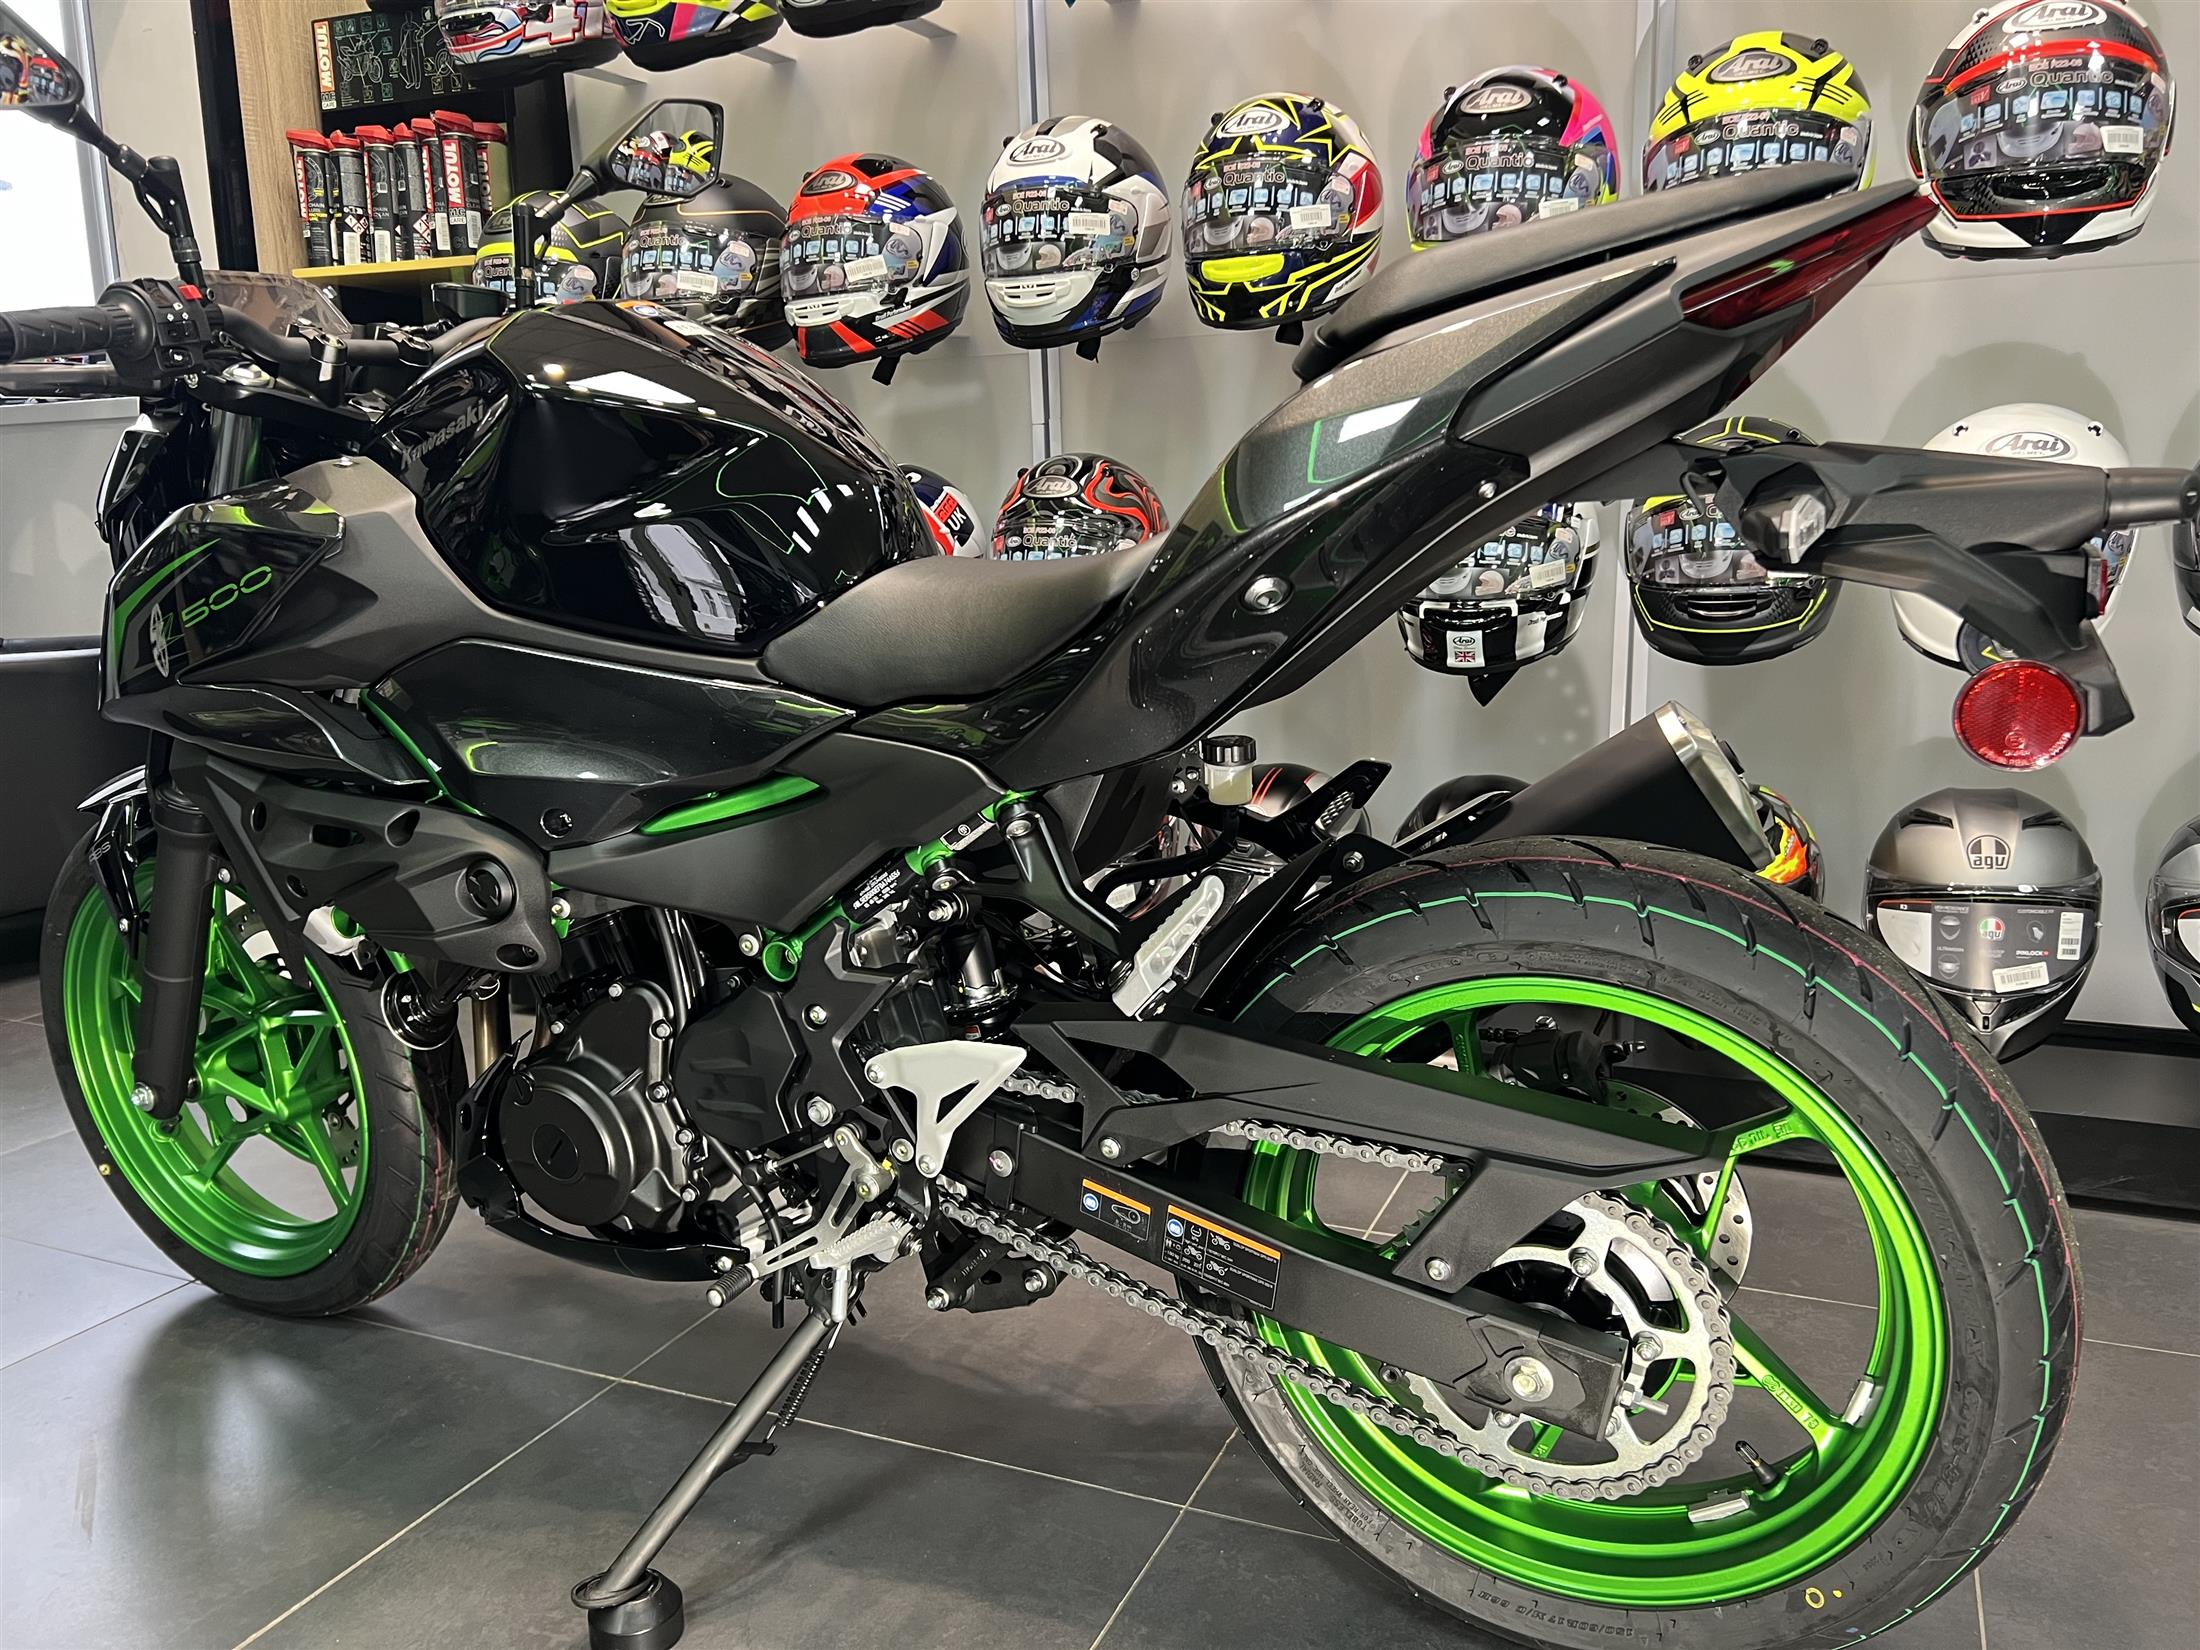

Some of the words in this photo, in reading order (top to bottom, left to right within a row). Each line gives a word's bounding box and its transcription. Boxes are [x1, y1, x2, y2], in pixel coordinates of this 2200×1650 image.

[2026, 2, 2087, 18] Arai
[315, 23, 333, 88] MOTUL
[1727, 56, 1780, 72] Arai
[2030, 70, 2113, 87] Quantic
[1472, 89, 1521, 105] Arai
[1233, 112, 1272, 126] Arai
[1723, 120, 1799, 140] Quantic
[1021, 142, 1056, 156] Arai
[1466, 151, 1534, 170] Quantic
[445, 142, 462, 204] MOTUL
[1223, 168, 1286, 186] Quantic
[813, 174, 845, 190] Arai
[1013, 197, 1070, 213] Quantic
[802, 222, 851, 238] Quantic
[639, 233, 688, 248] Quantic
[485, 267, 512, 278] Quan
[401, 399, 484, 470] Kawasaki
[1999, 433, 2061, 453] Arai
[1030, 480, 1071, 493] Arai
[947, 507, 967, 531] UK
[1023, 532, 1077, 547] Quantic
[1973, 855, 2006, 869] agv
[1327, 1495, 1369, 1531] TUBELESS
